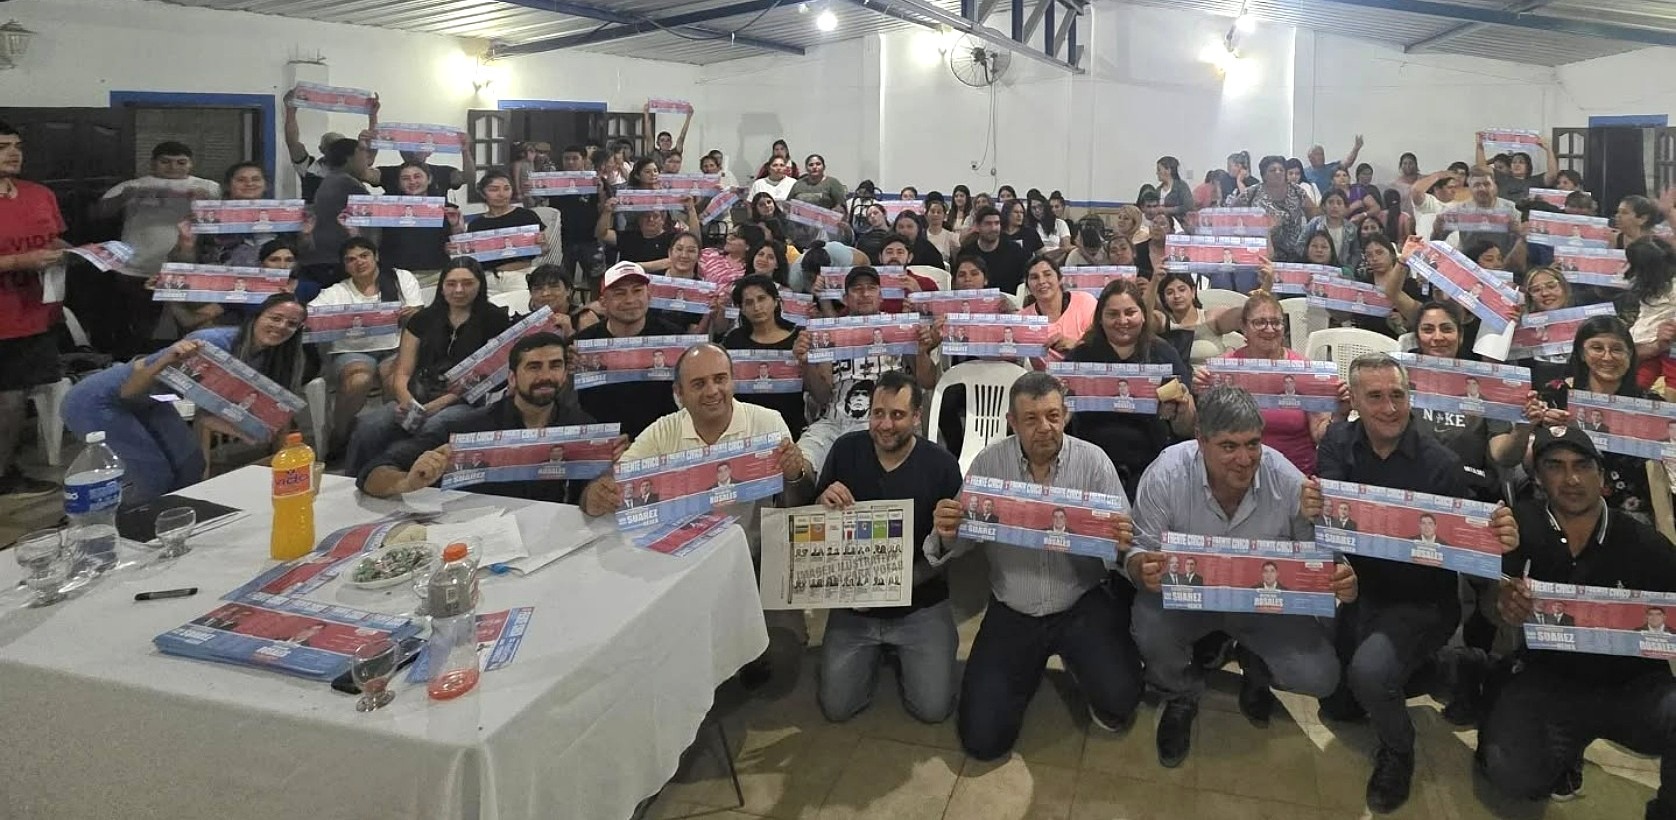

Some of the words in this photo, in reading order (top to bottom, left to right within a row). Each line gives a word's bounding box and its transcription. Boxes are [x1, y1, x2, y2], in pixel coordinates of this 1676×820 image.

[620, 459, 641, 474] FRENTE
[626, 509, 659, 524] SUAREZ
[1172, 591, 1202, 602] SUAREZ
[1537, 631, 1575, 643] SUAREZ
